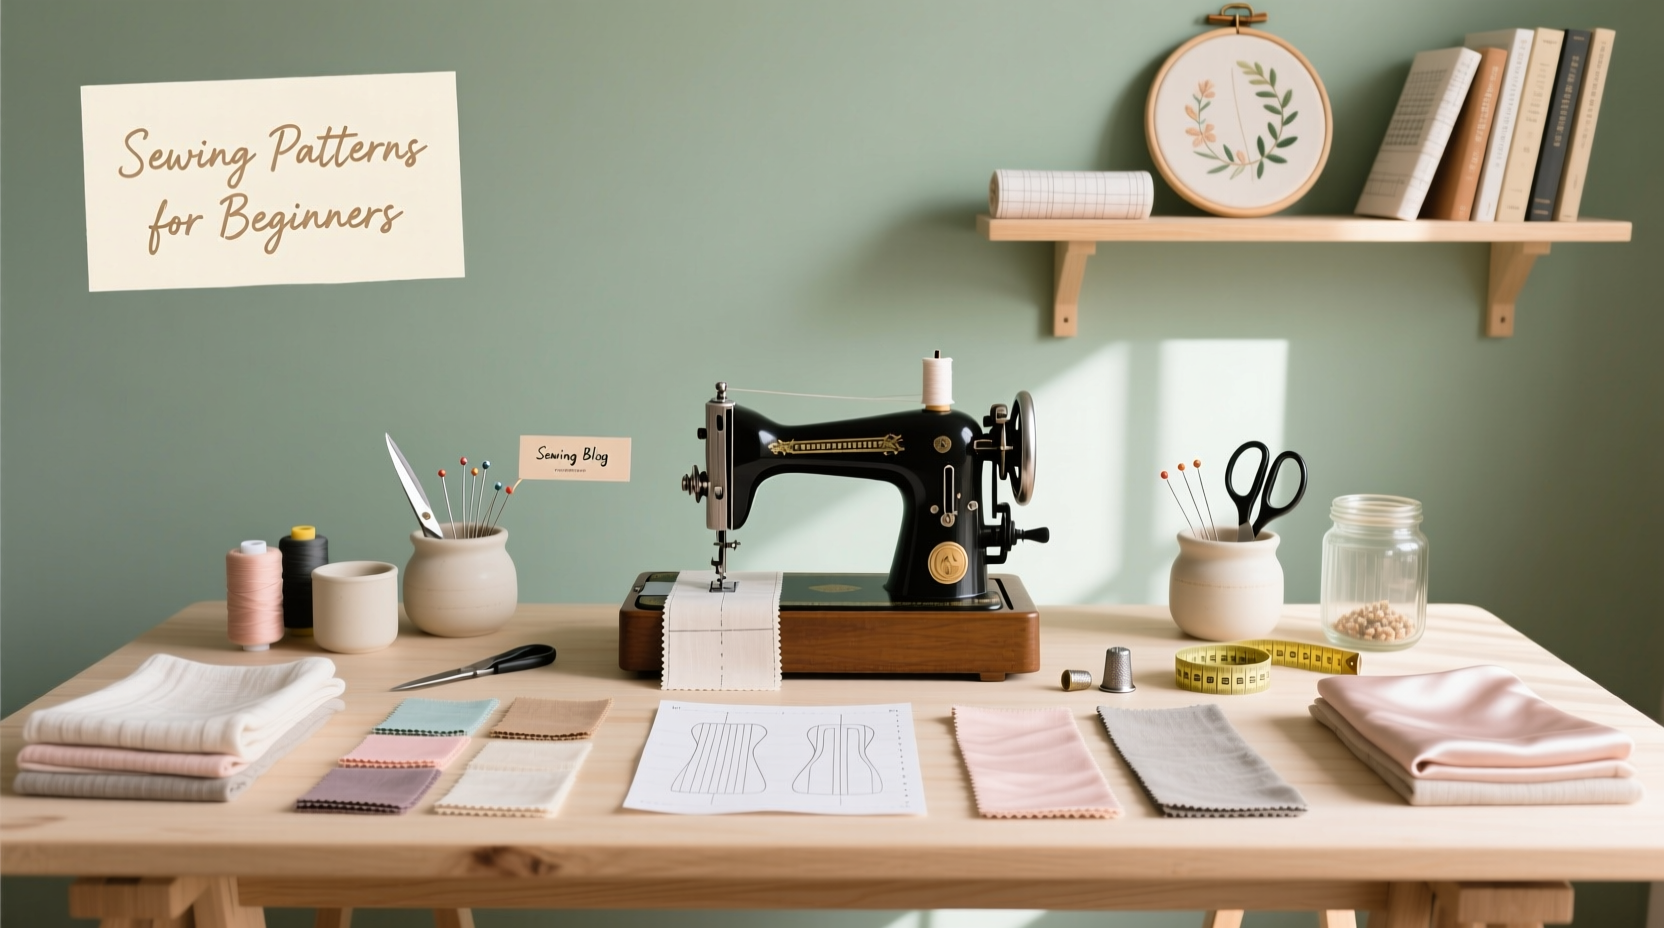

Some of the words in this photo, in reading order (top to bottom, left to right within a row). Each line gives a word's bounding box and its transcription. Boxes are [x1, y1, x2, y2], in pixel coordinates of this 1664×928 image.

[118, 127, 256, 189] Sewing
[268, 123, 428, 173] Patterns
[148, 198, 204, 255] for
[219, 192, 404, 255] Beginners
[582, 446, 609, 467] Blog
